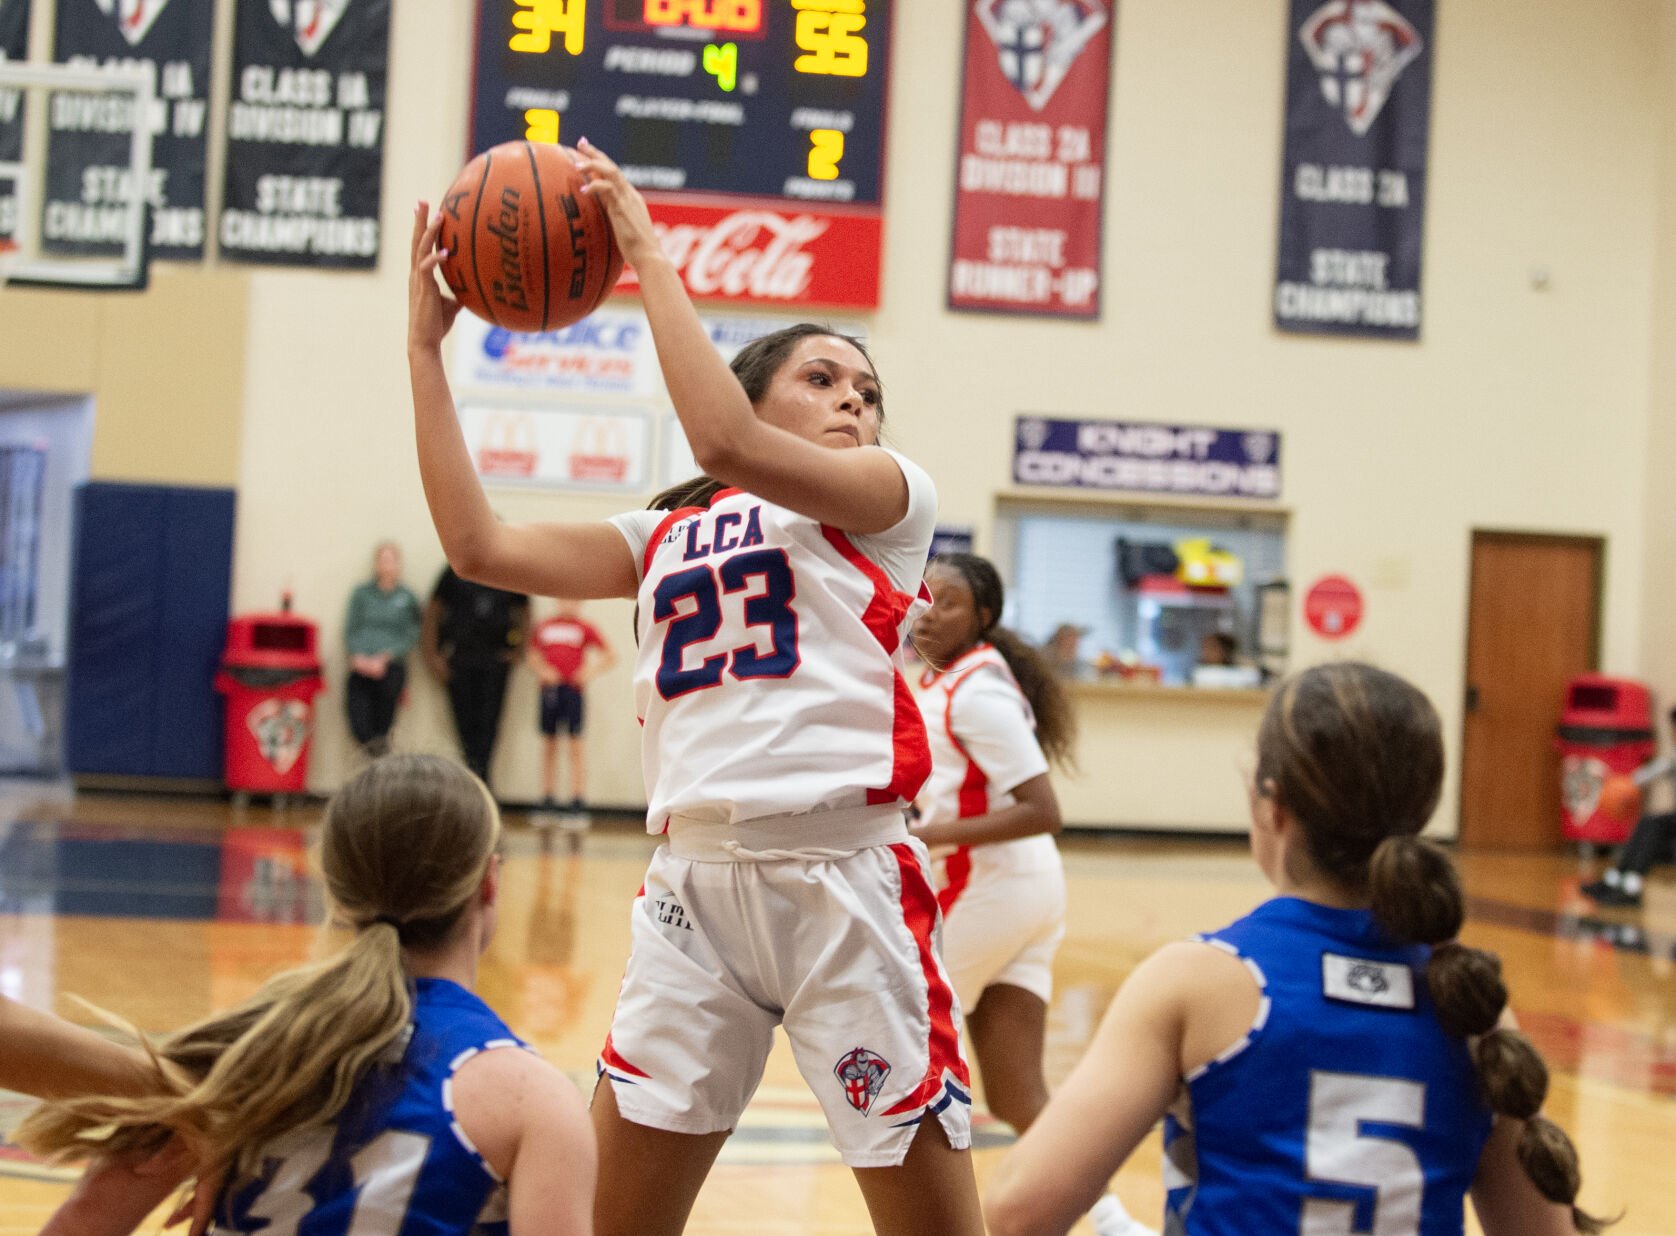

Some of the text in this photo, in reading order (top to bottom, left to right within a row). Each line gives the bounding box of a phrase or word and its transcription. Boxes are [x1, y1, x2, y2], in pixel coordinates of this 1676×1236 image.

[603, 45, 697, 77] PERIOD
[703, 42, 738, 92] 4
[240, 65, 331, 106] CLASS
[230, 102, 343, 146] DIVISION
[974, 120, 1053, 159] CLASS
[807, 129, 844, 180] 2
[959, 154, 1069, 198] DIVISION
[81, 165, 170, 208] STAE
[256, 175, 344, 217] STATE
[1294, 164, 1375, 205] CLASS
[45, 201, 202, 248] CHAMONS
[219, 210, 378, 257] CHAMPIONS
[987, 226, 1068, 268] STATE
[488, 187, 529, 312] Baden
[1309, 248, 1391, 289] STATE
[950, 261, 1098, 307] RUNNER-UP
[1276, 283, 1421, 329] CHAMPIONS
[1077, 422, 1219, 459] KNIGHT
[1014, 451, 1280, 498] CONCESSIONS
[682, 504, 765, 563] LCA
[653, 548, 801, 701] 23
[1299, 1069, 1427, 1236] 5
